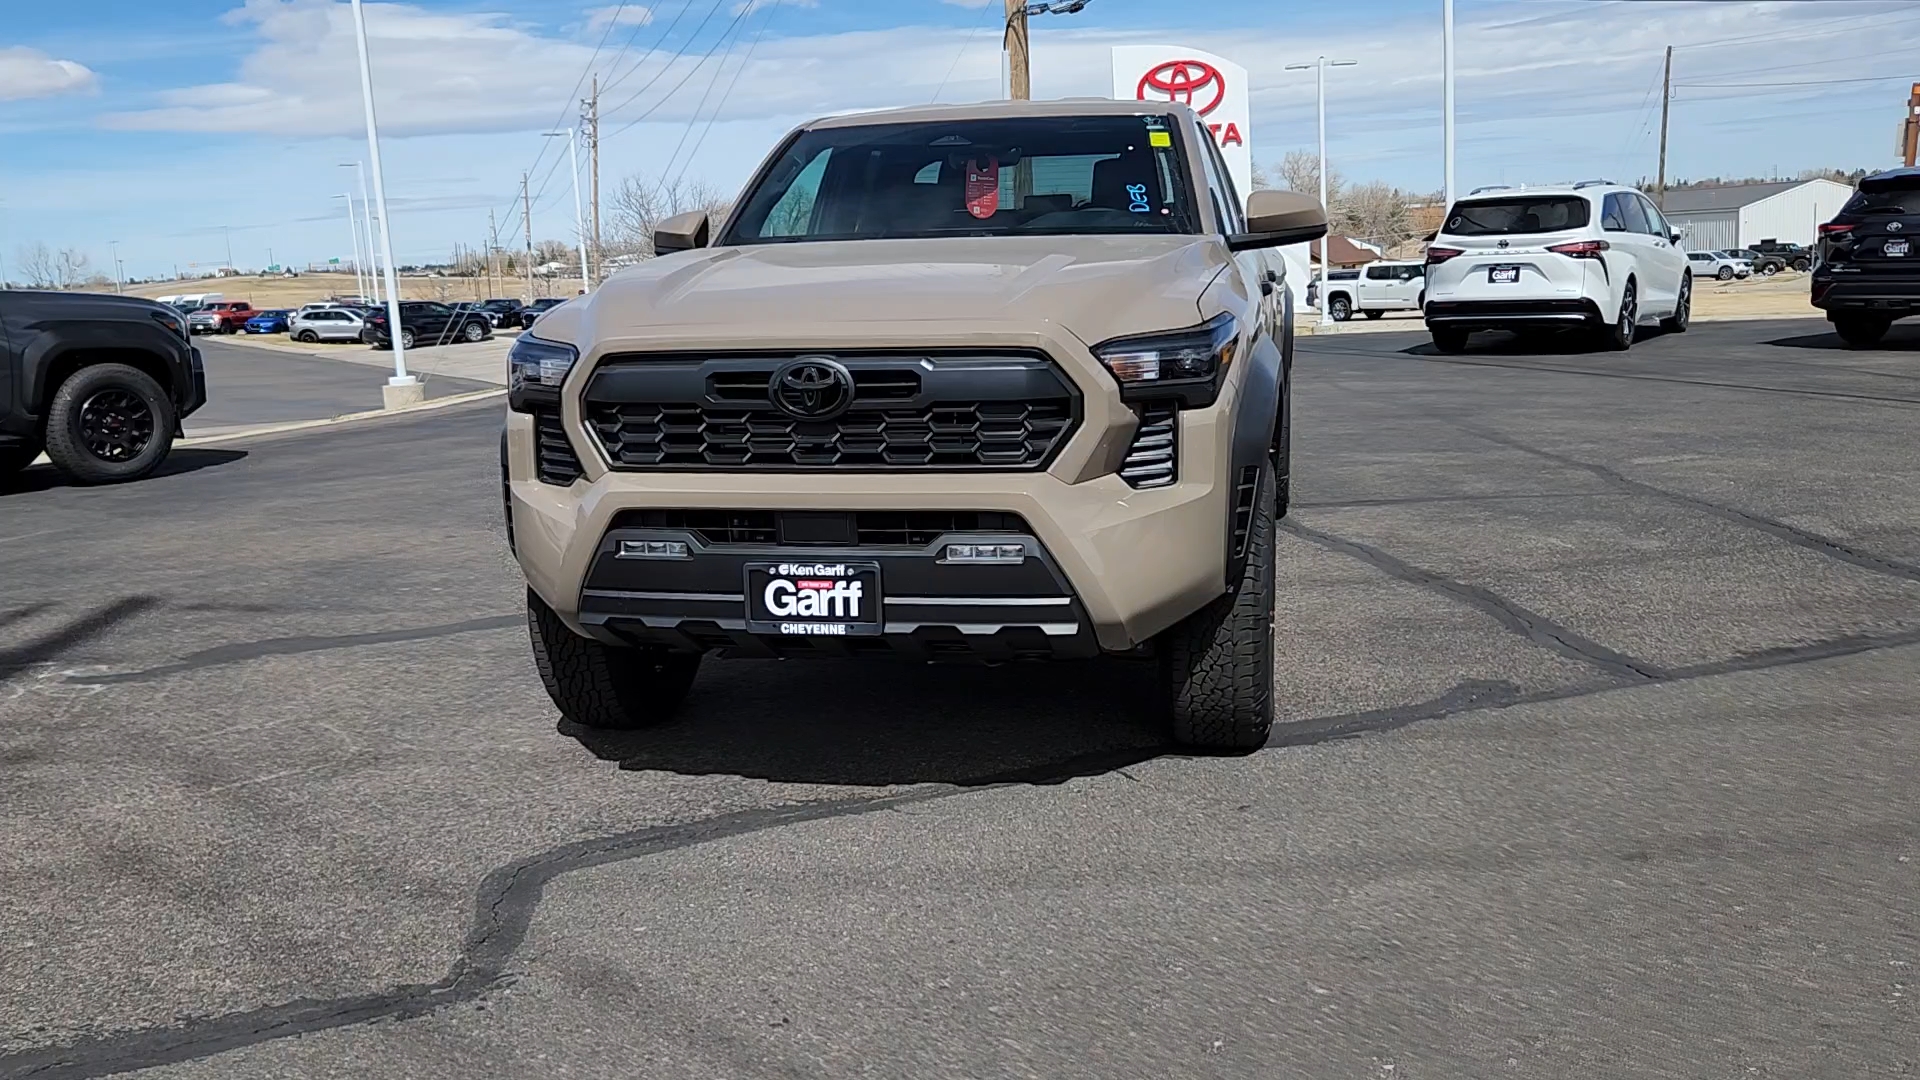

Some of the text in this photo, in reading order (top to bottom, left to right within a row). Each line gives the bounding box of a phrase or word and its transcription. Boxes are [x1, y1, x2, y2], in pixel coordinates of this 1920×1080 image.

[1884, 242, 1909, 253] Garff
[1492, 270, 1517, 280] Garff
[790, 564, 846, 576] Ken Garff
[764, 579, 862, 617] Garff
[780, 623, 846, 635] CHEYENNE
